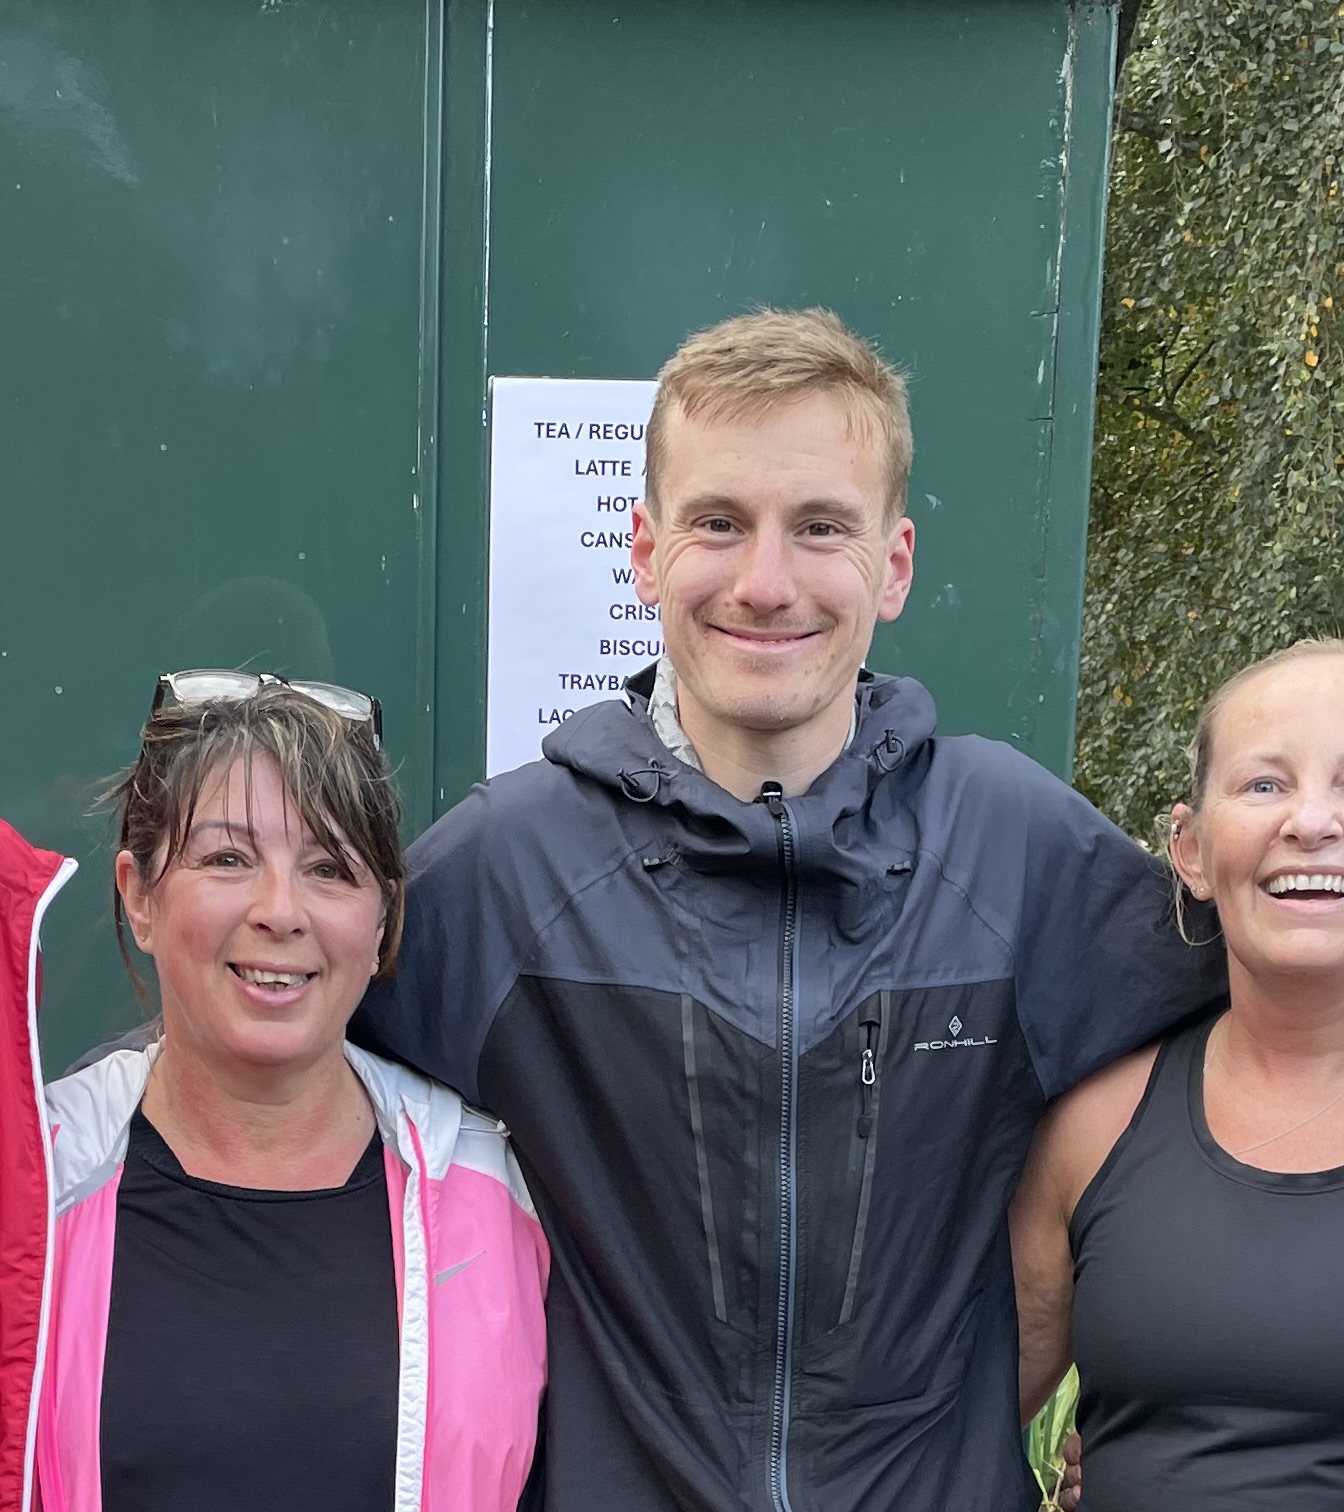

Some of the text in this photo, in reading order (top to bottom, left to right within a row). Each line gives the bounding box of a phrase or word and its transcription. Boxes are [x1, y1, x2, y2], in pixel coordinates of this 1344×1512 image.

[534, 423, 647, 440] TEA / REGU
[575, 459, 631, 476] LATTE
[597, 496, 638, 512] HOT
[580, 531, 633, 548] CANS
[612, 568, 635, 584] W
[914, 1036, 998, 1051] RONHILL
